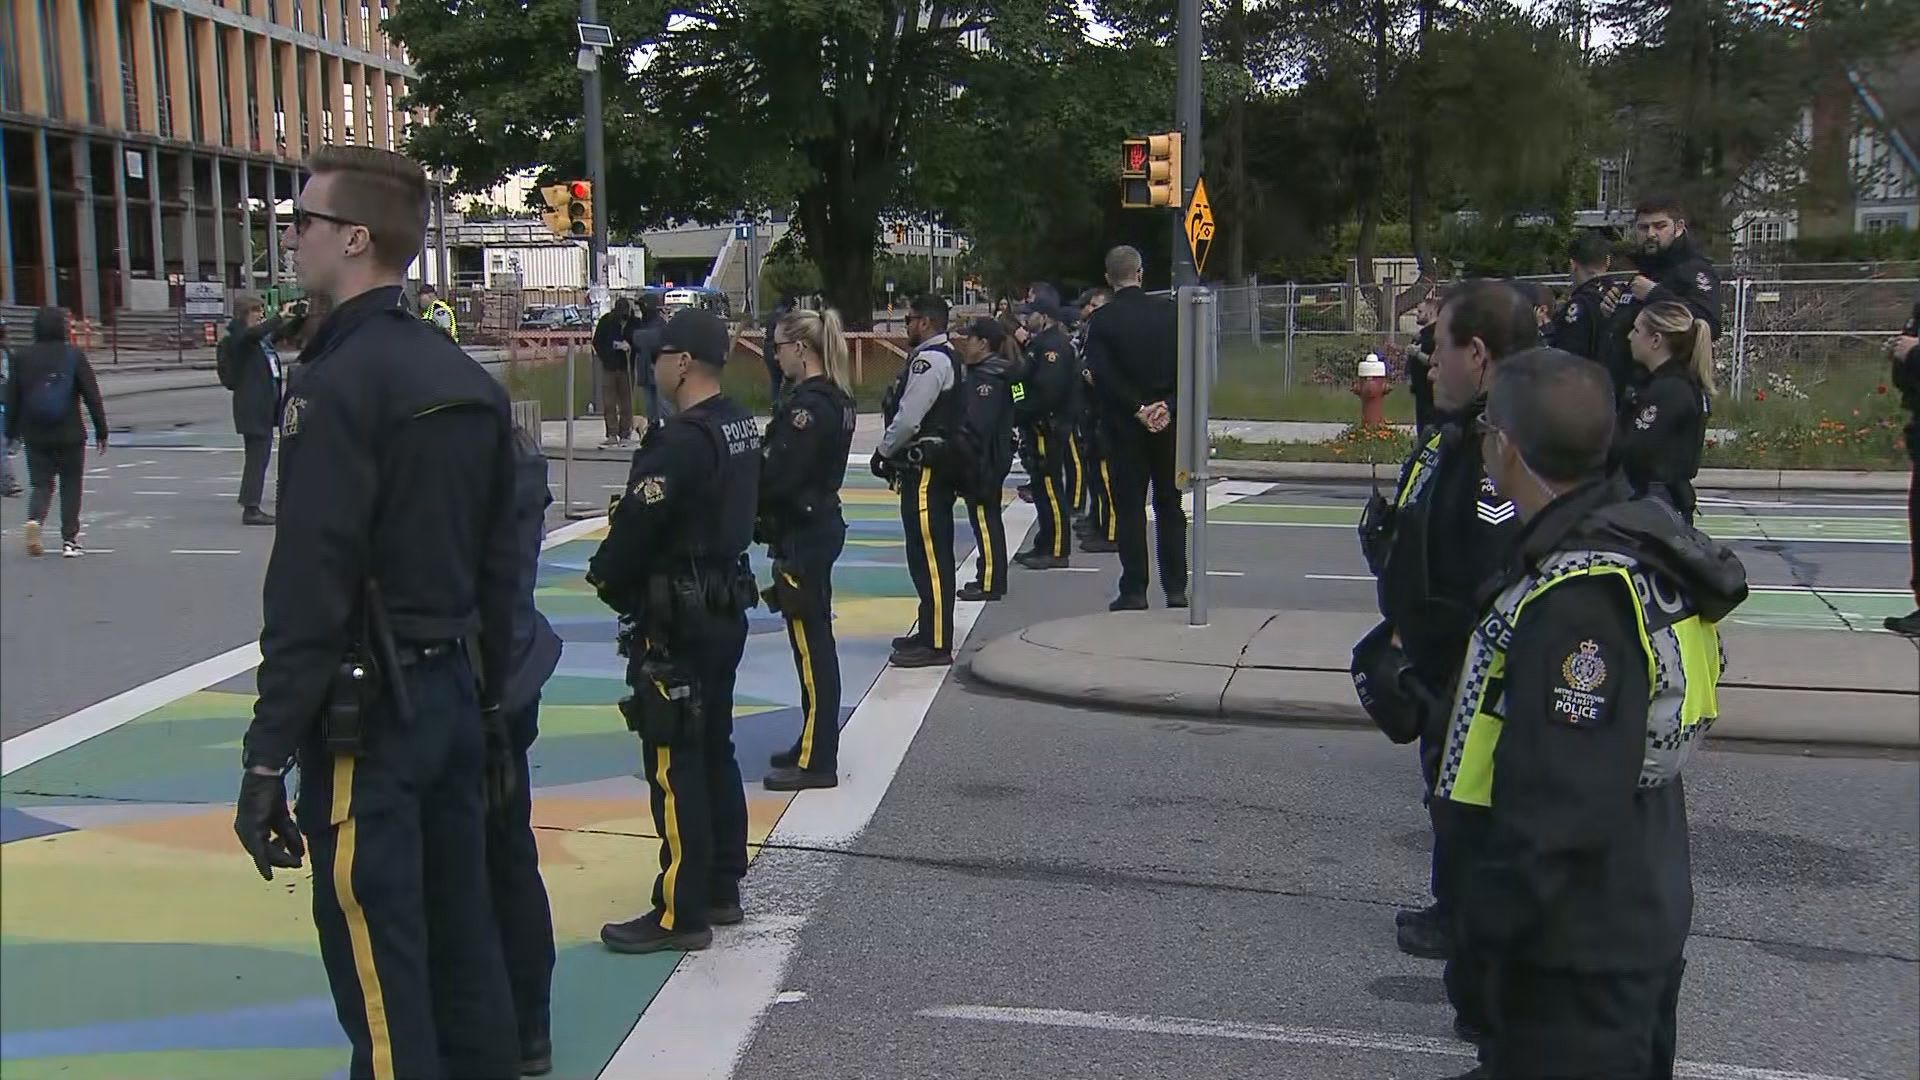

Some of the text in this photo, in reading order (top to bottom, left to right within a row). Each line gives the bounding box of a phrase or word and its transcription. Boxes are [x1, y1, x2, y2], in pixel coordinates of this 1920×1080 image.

[721, 418, 759, 441] POLICE
[1481, 484, 1498, 497] POL
[1632, 573, 1684, 624] PO
[1480, 613, 1512, 649] ICE
[1554, 699, 1599, 720] POLICE
[1562, 694, 1596, 708] TRANSIT
